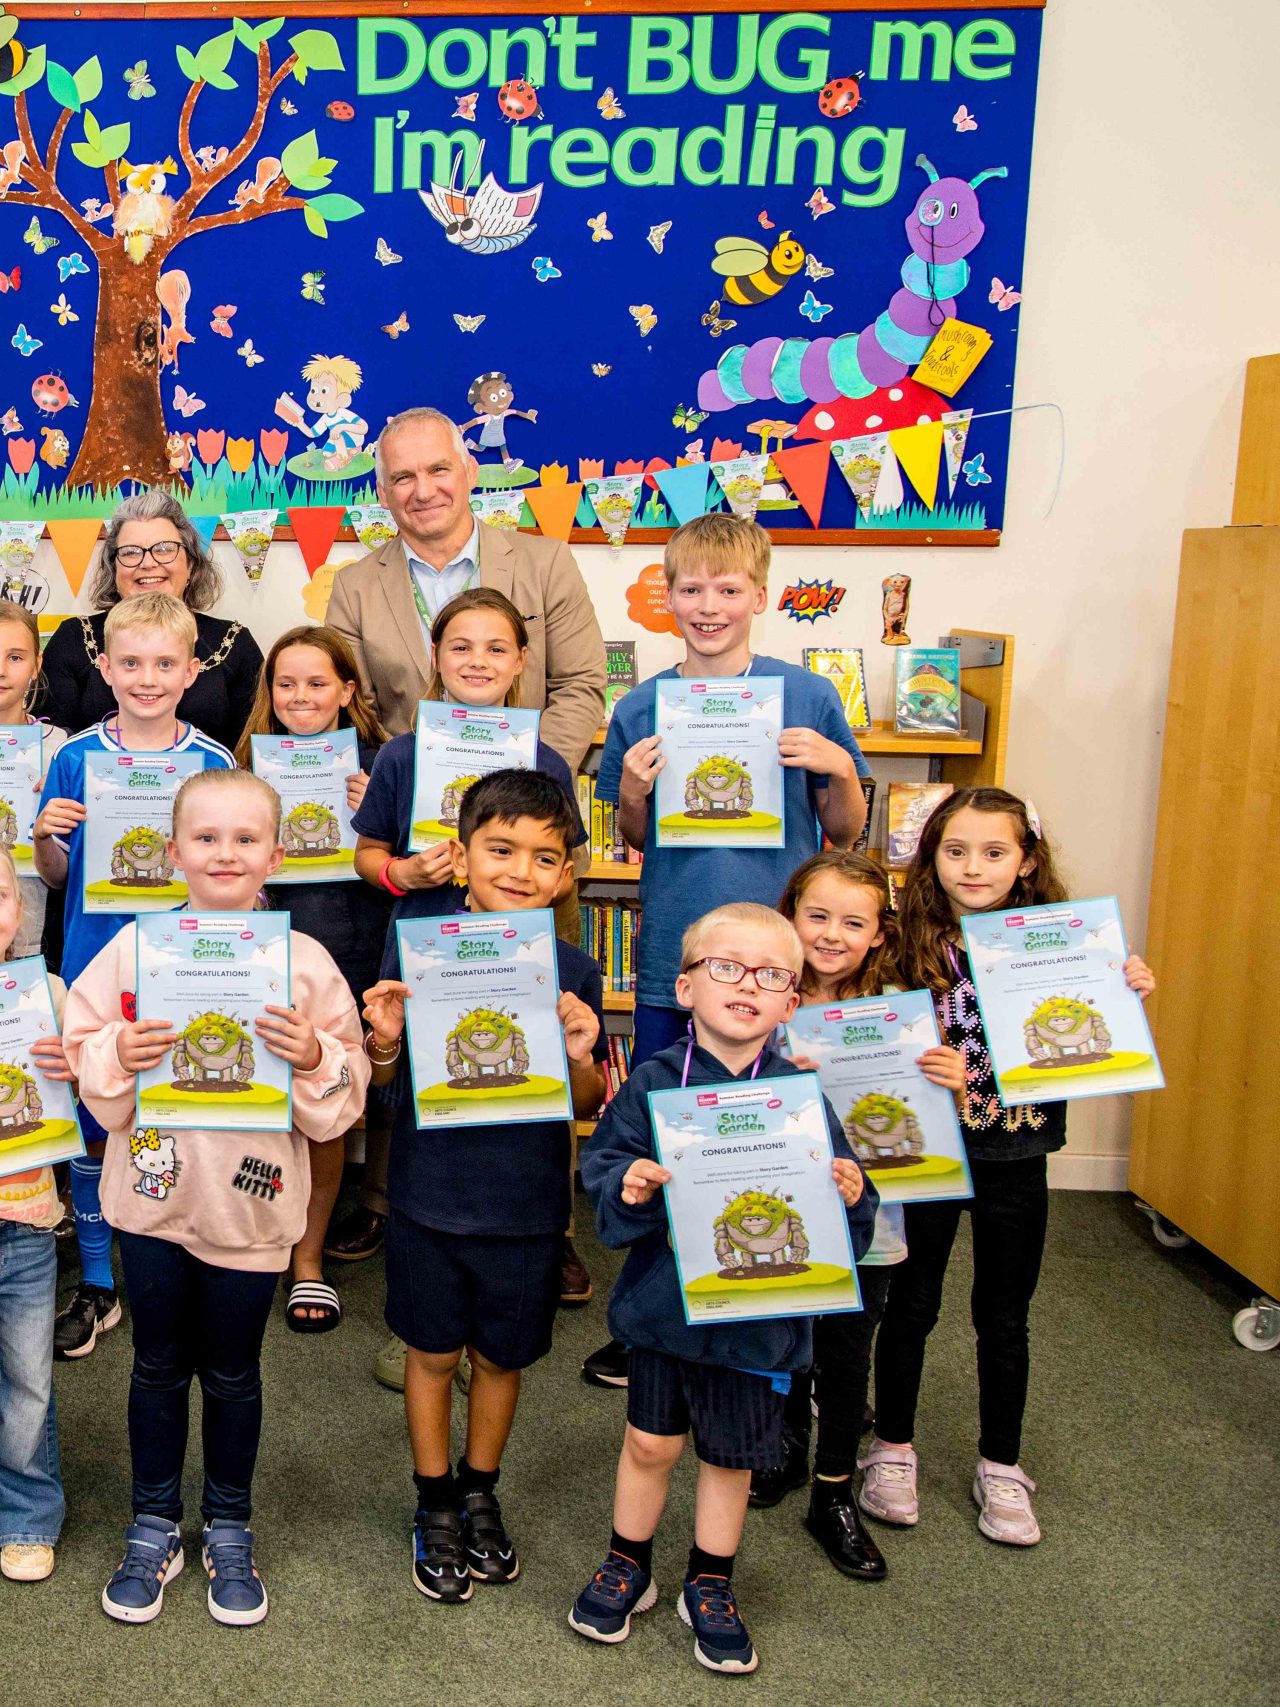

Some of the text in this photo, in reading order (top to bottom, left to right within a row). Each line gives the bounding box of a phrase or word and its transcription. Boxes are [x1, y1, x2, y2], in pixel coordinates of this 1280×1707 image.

[357, 12, 1016, 94] Don't BUG me
[373, 104, 906, 204] I'm reading
[778, 585, 846, 612] POW!
[705, 698, 734, 708] Story
[702, 707, 737, 715] Garden
[465, 725, 491, 735] Story
[461, 733, 494, 742] Garden
[446, 747, 505, 756] CONGRATULATIONS!
[132, 772, 158, 781] Story
[129, 779, 161, 787] Garden
[1027, 931, 1061, 942] Story
[197, 938, 231, 950] Story
[461, 940, 494, 951] Story
[1024, 939, 1068, 951] Garden
[193, 949, 235, 959] Garden
[457, 949, 500, 959] Garden
[1011, 955, 1087, 969] CONGRATULATIONS!
[441, 967, 517, 978] CONGRATULATIONS!
[845, 1025, 877, 1036] Story
[721, 1112, 758, 1125] Story
[717, 1122, 765, 1135] Garden
[702, 1142, 787, 1157] CONGRATULATIONS!
[241, 1157, 282, 1179] HELLO
[233, 1173, 277, 1201] KITTY
